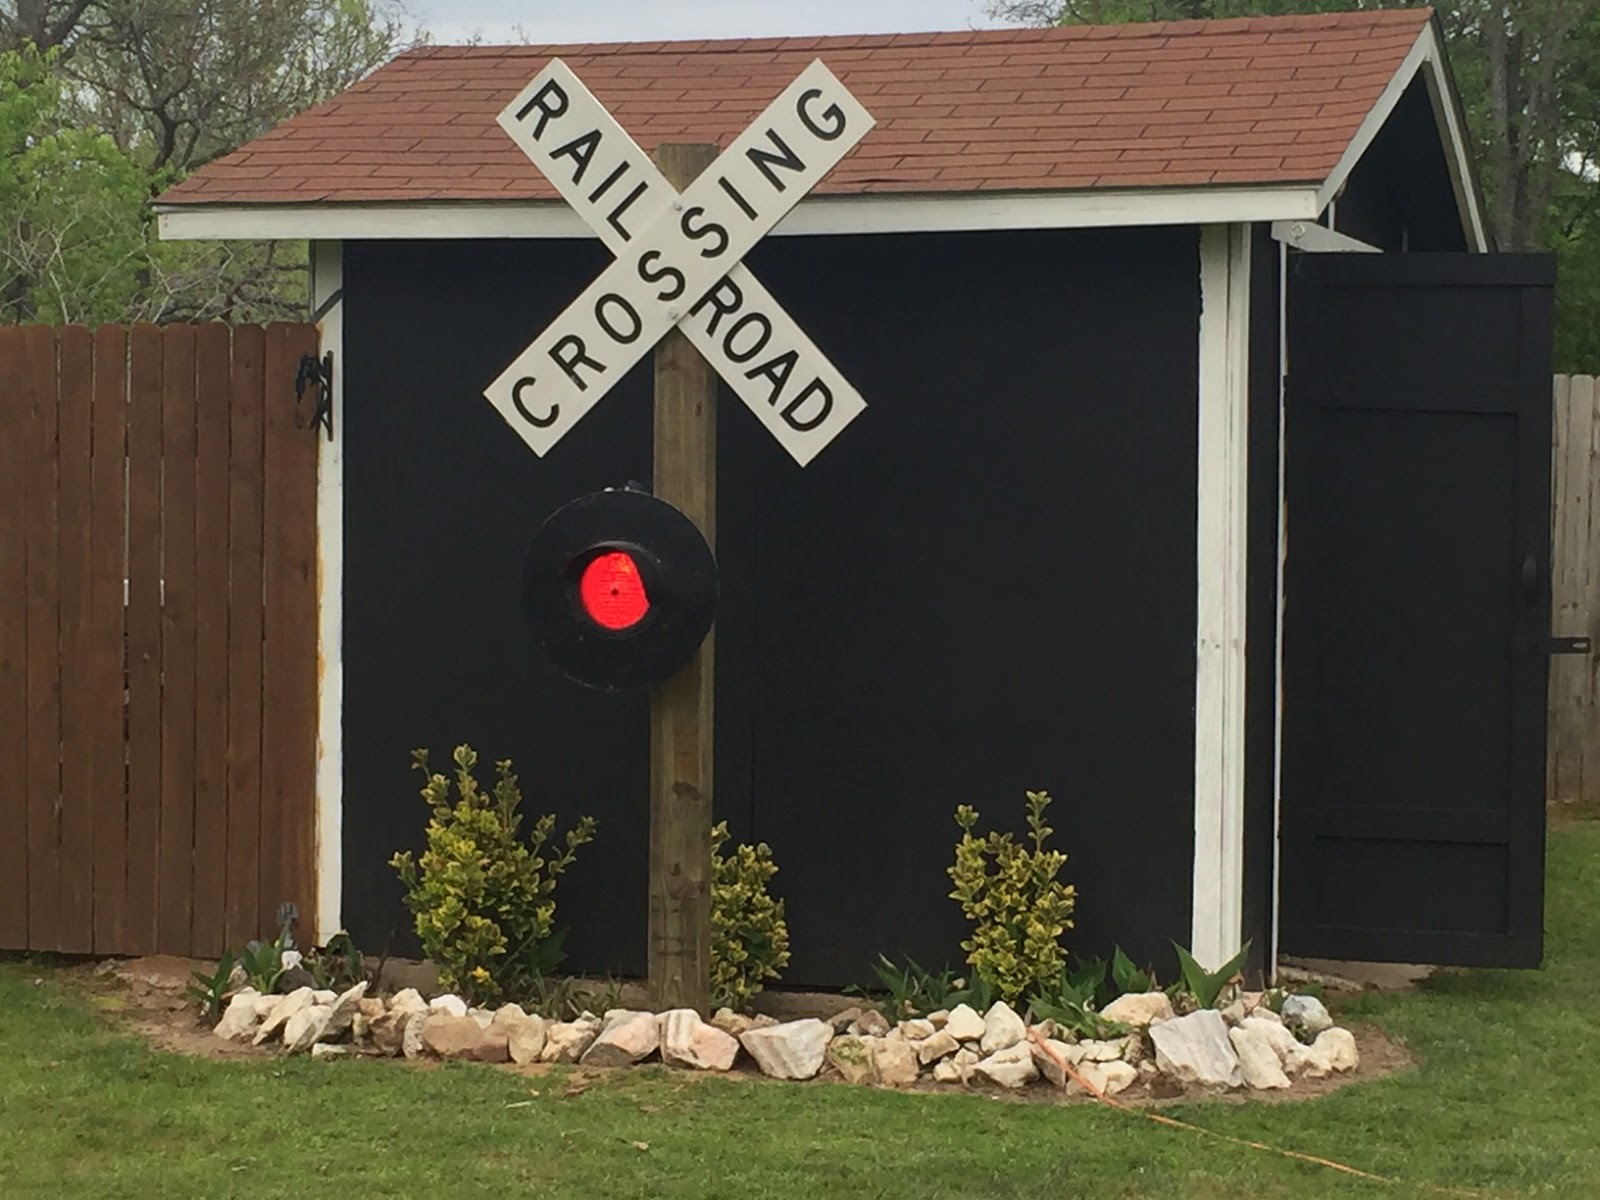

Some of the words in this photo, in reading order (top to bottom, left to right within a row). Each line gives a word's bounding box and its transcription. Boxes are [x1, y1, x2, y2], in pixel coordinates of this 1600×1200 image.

[511, 88, 847, 428] CROSSING
[515, 78, 649, 242] RAIL
[688, 274, 834, 432] ROAD
